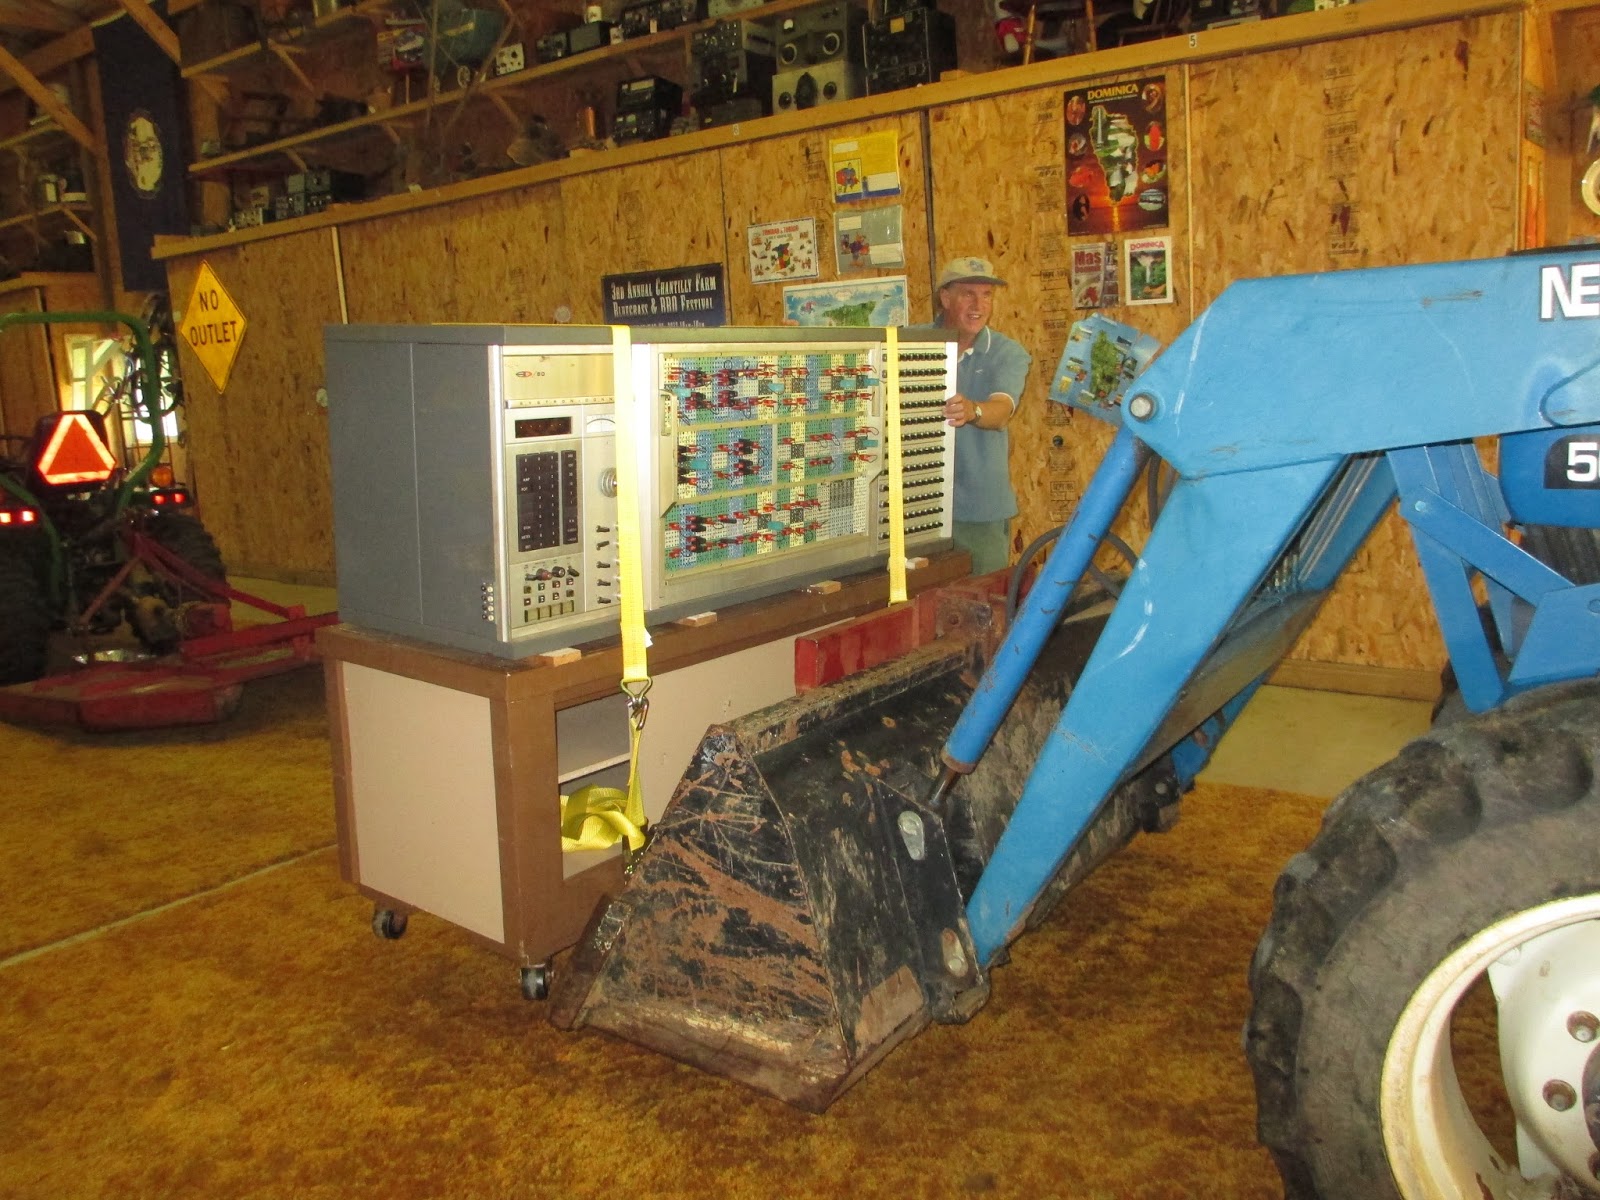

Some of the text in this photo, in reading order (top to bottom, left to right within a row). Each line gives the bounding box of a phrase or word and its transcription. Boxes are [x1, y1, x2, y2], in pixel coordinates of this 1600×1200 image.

[1087, 84, 1139, 100] DOMINICA
[1130, 241, 1165, 251] DOMINICA
[1074, 251, 1101, 265] Mas
[611, 273, 717, 301] 3RD ANNUAL CHANTILLY FARM
[199, 290, 219, 312] NO
[650, 298, 657, 314] &
[680, 295, 714, 312] FESTIVAL
[190, 320, 237, 346] OUTLET
[1567, 442, 1600, 482] 5
